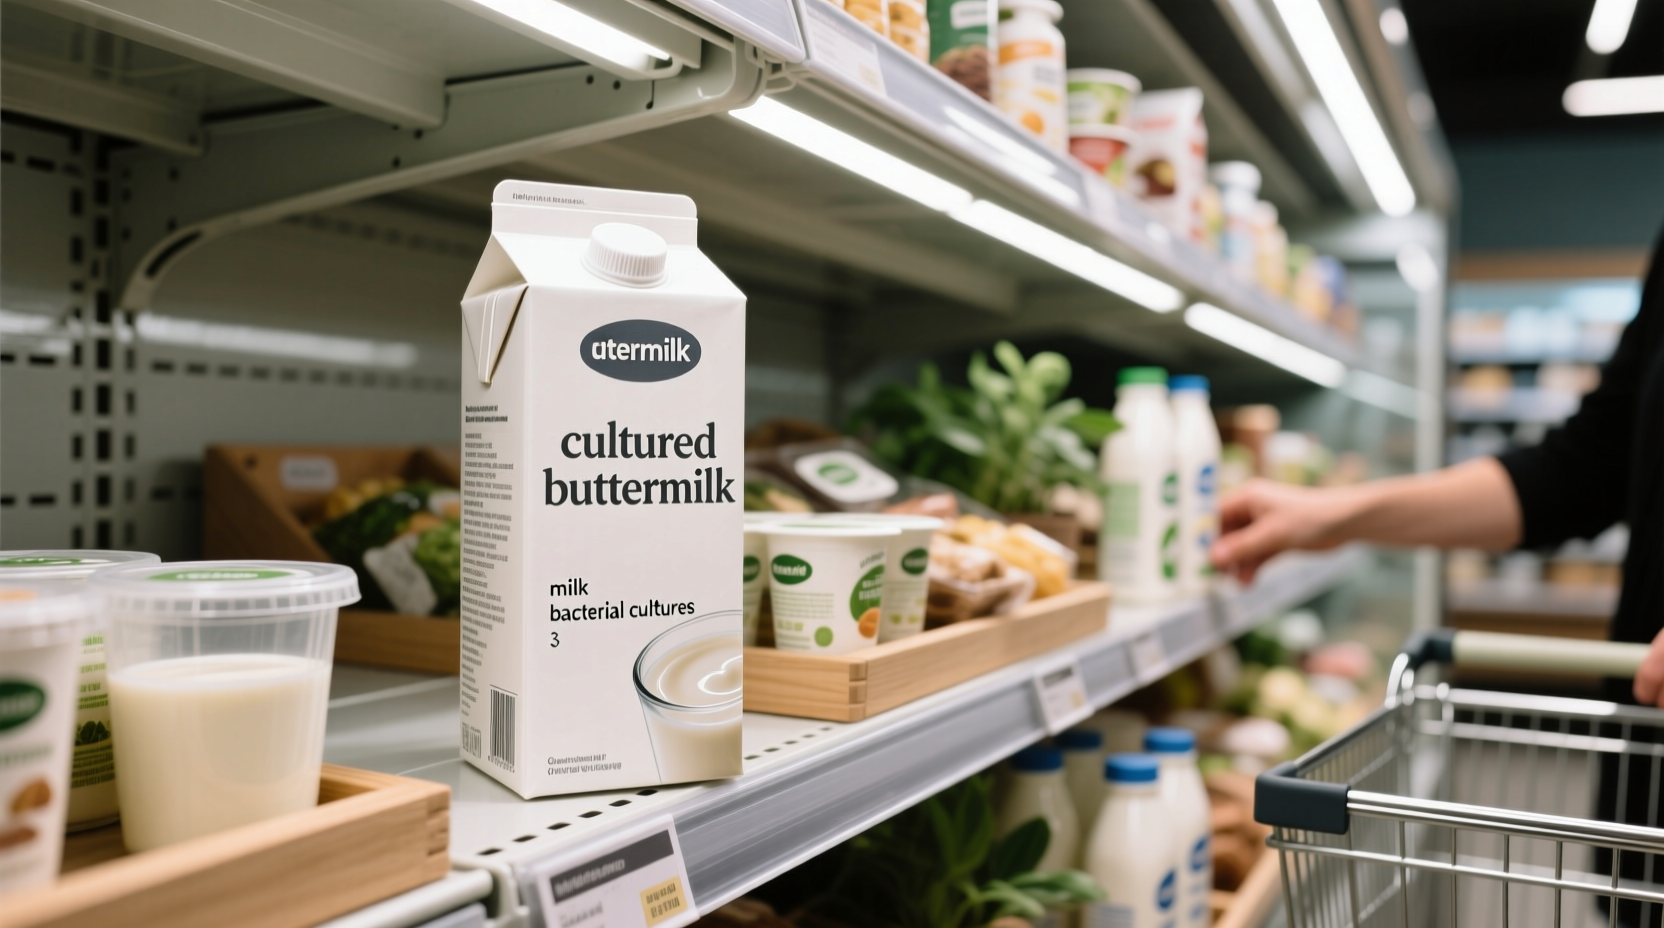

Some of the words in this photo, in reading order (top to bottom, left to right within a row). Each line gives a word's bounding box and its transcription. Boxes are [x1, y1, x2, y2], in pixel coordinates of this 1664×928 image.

[561, 420, 717, 459] cultured
[542, 467, 736, 506] buttermilk
[550, 578, 588, 596] milk
[550, 600, 624, 621] bacterial
[629, 599, 695, 618] cultures
[550, 632, 560, 648] 3
